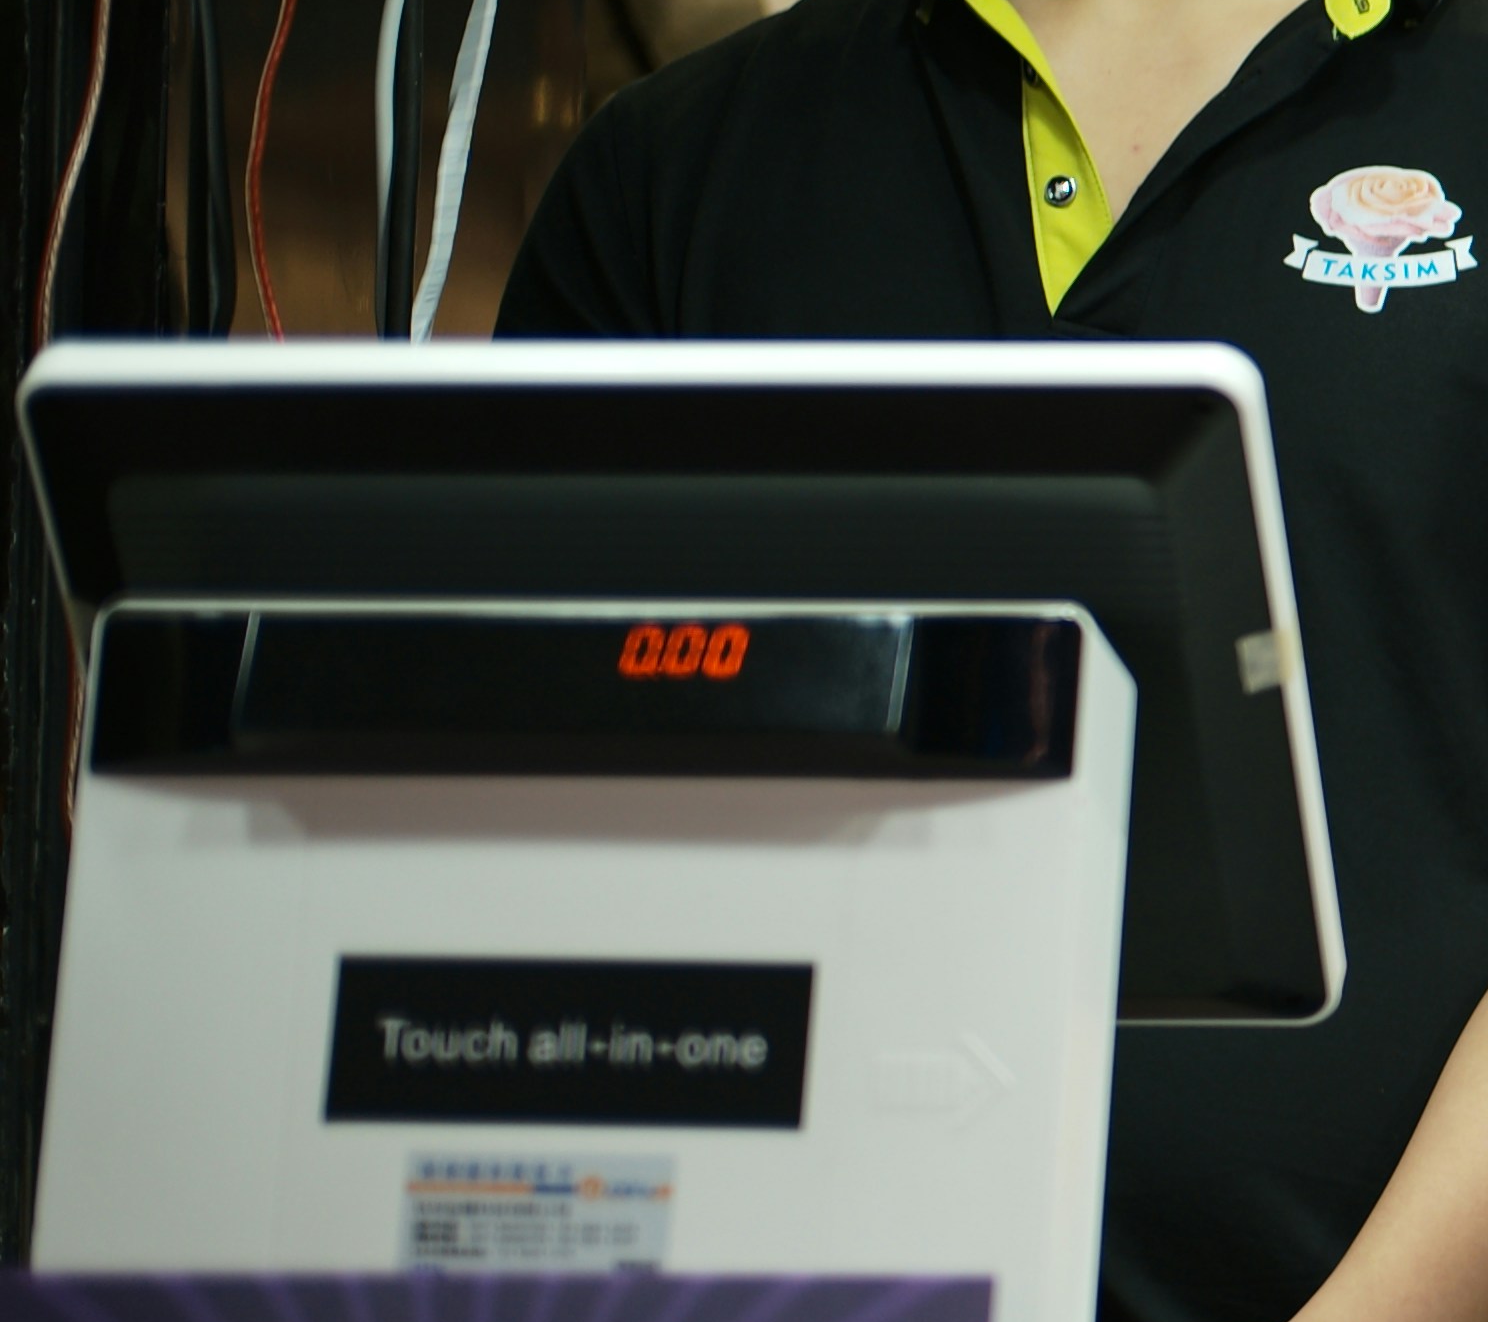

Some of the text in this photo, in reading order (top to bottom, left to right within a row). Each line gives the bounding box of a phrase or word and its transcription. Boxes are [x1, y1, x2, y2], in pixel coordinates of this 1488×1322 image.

[1321, 258, 1439, 281] TAKSIM
[378, 1015, 769, 1069] Touch all-in-one
